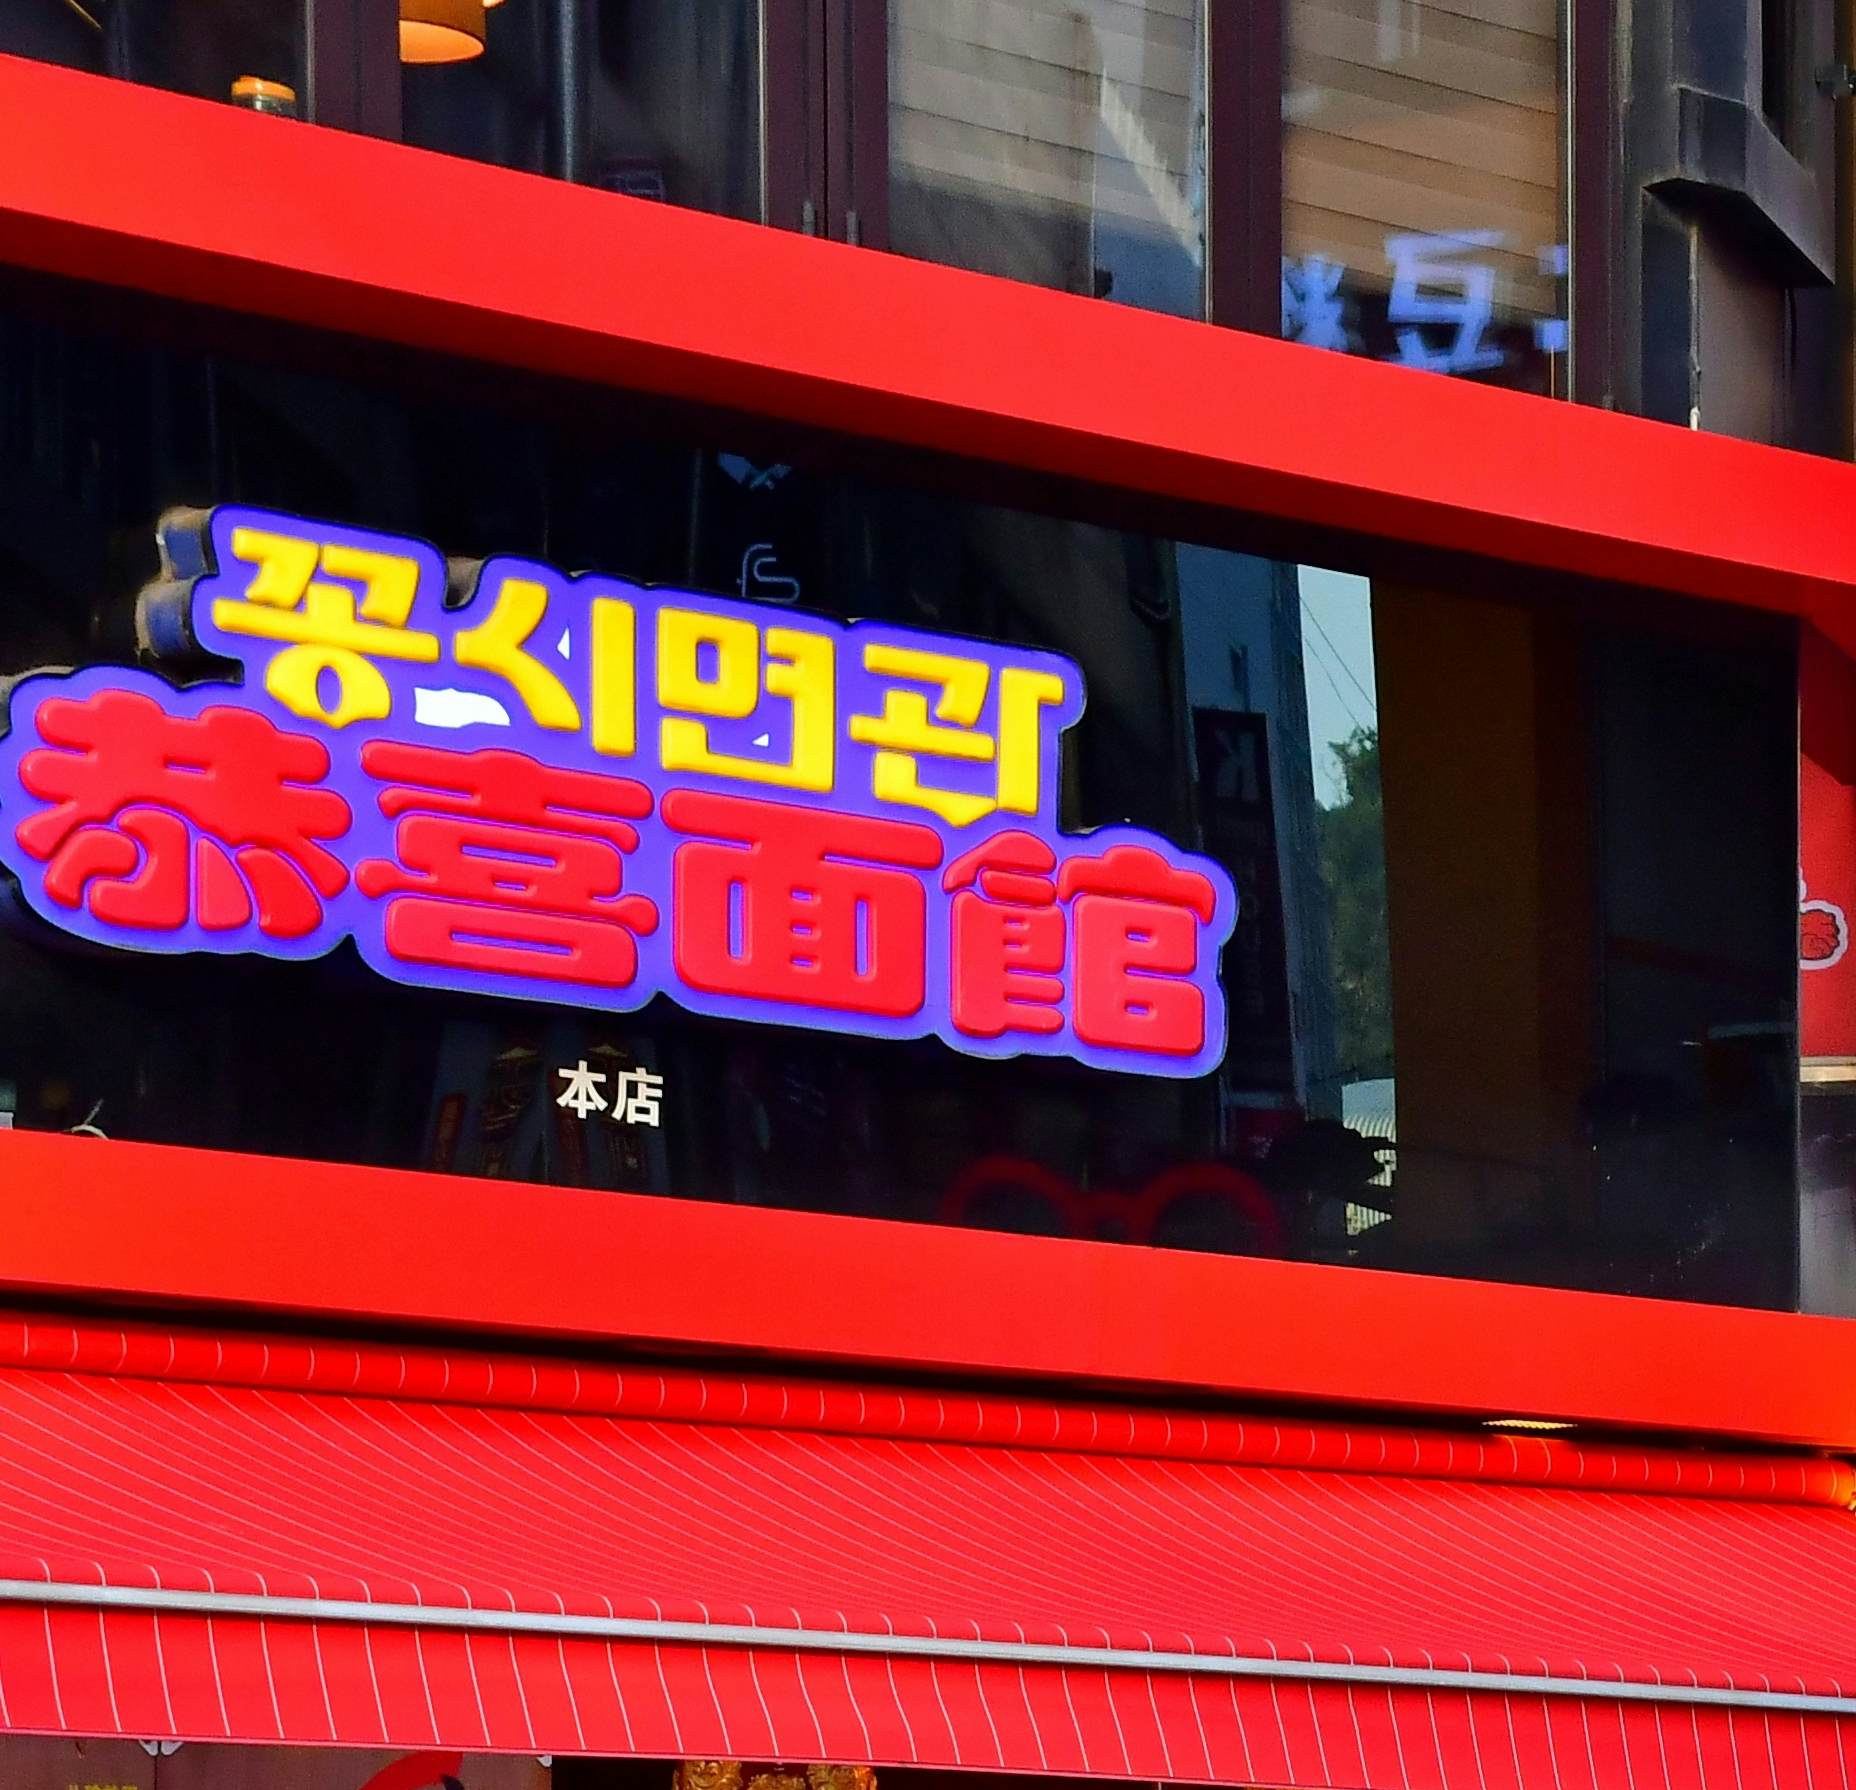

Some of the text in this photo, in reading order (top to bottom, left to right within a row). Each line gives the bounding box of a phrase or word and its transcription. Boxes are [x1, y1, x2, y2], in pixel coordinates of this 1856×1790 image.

[213, 526, 1066, 827] 꽁시면관
[15, 686, 1217, 1059] 恭喜面館
[555, 1060, 664, 1128] 本店
